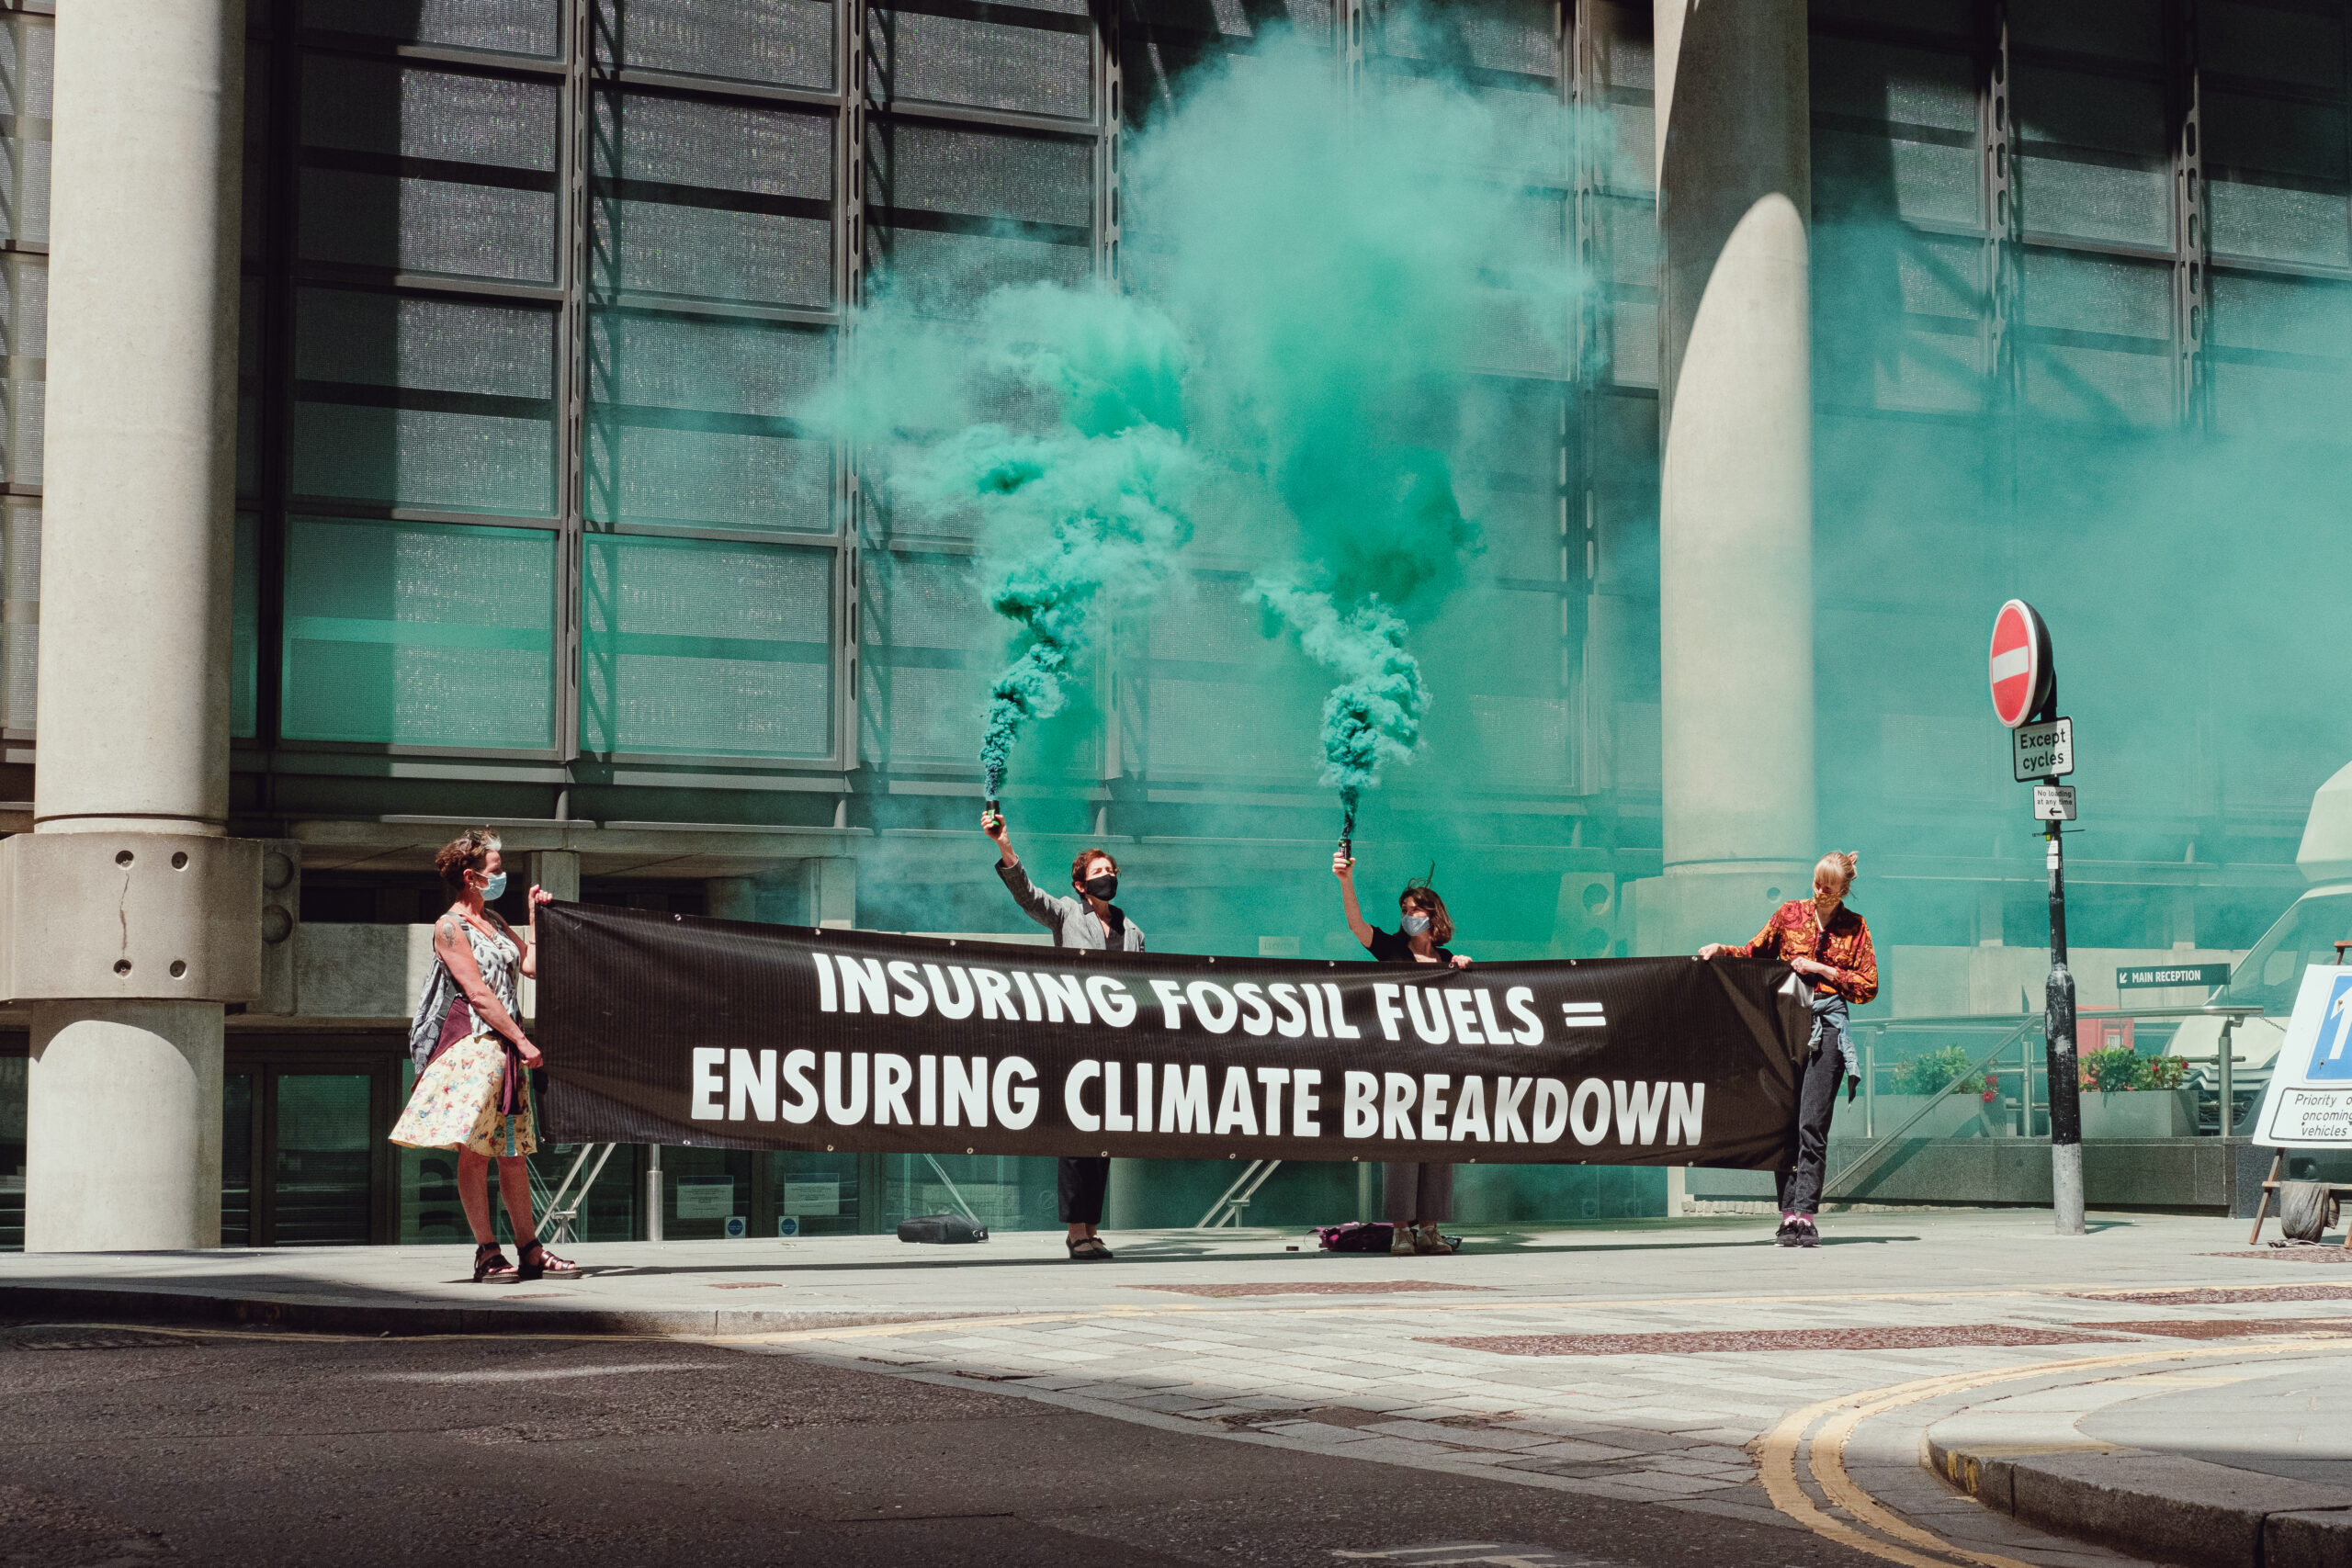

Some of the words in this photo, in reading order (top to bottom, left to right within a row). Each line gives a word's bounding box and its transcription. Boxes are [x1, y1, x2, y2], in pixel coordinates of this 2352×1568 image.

[2020, 728, 2065, 749] Except
[2023, 750, 2064, 772] cycles
[2049, 790, 2072, 798] loading
[2132, 972, 2153, 983] MAIN
[2155, 970, 2201, 982] RECEPTION
[812, 953, 1137, 1028] INSURING
[1149, 979, 1362, 1039] FOSSIL
[1373, 983, 1544, 1046] FUELS
[1563, 1002, 1607, 1027] =
[691, 1046, 1040, 1130] ENSURING
[1065, 1059, 1321, 1137] CLIMATE
[1343, 1070, 1705, 1146] BREAKDOWN
[2295, 1094, 2337, 1108] Priority
[2301, 1125, 2347, 1136] vehicles
